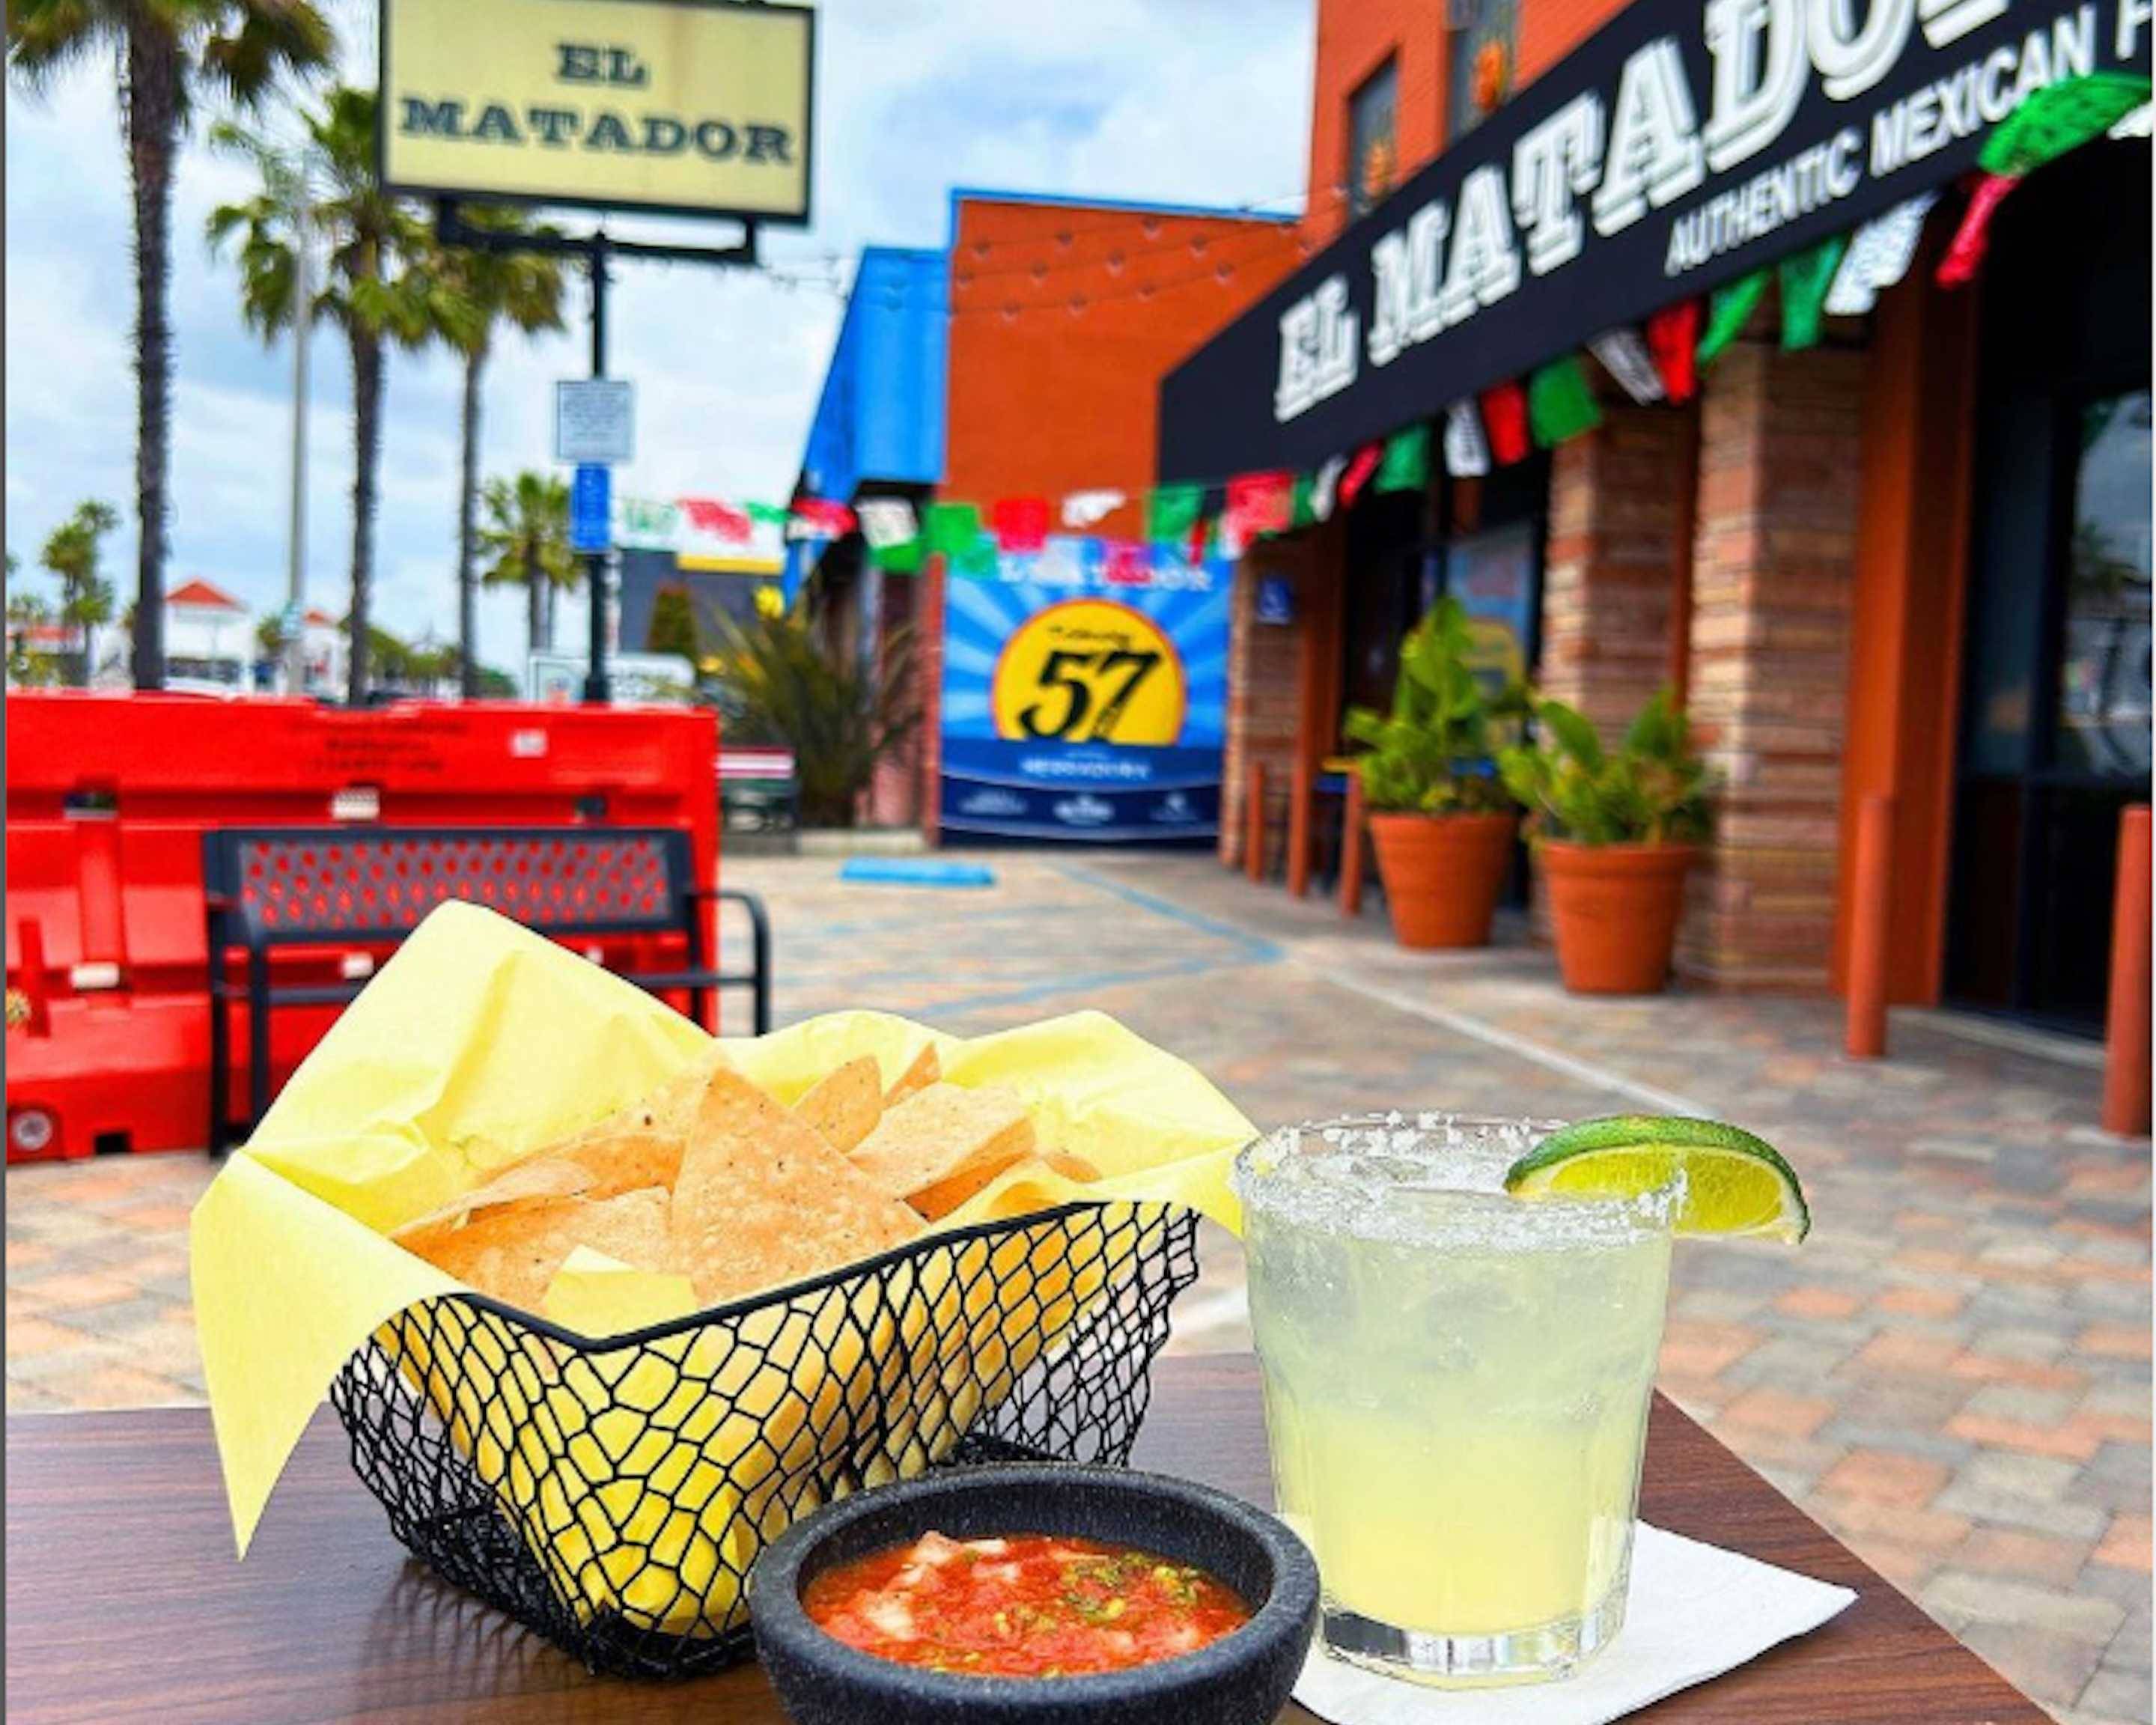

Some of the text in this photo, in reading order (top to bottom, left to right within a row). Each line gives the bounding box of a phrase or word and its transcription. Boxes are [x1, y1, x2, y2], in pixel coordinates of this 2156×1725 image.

[556, 43, 647, 85] EL
[401, 97, 793, 165] MATADOR
[1663, 126, 1864, 278] AUTHENTIC
[1870, 4, 2095, 178] MEXICAN
[1274, 0, 2009, 422] EL MATAD
[1018, 650, 1162, 743] 57
